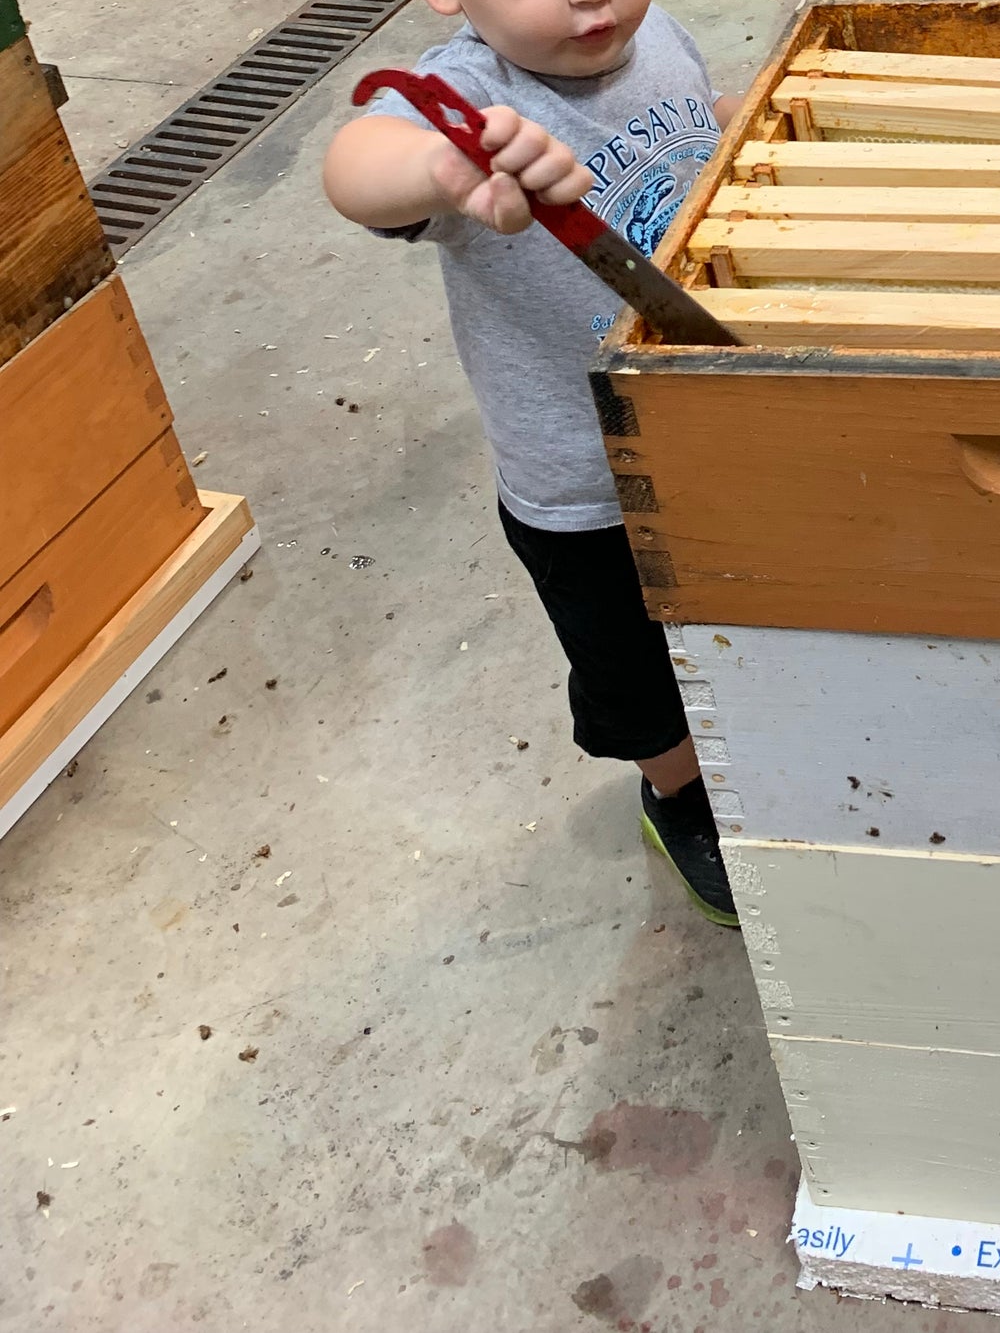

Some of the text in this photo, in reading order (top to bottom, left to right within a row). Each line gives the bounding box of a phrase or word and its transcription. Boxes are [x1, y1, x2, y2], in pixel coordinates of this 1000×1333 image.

[626, 97, 687, 150] SAN
[684, 97, 721, 135] BL
[641, 161, 669, 185] State
